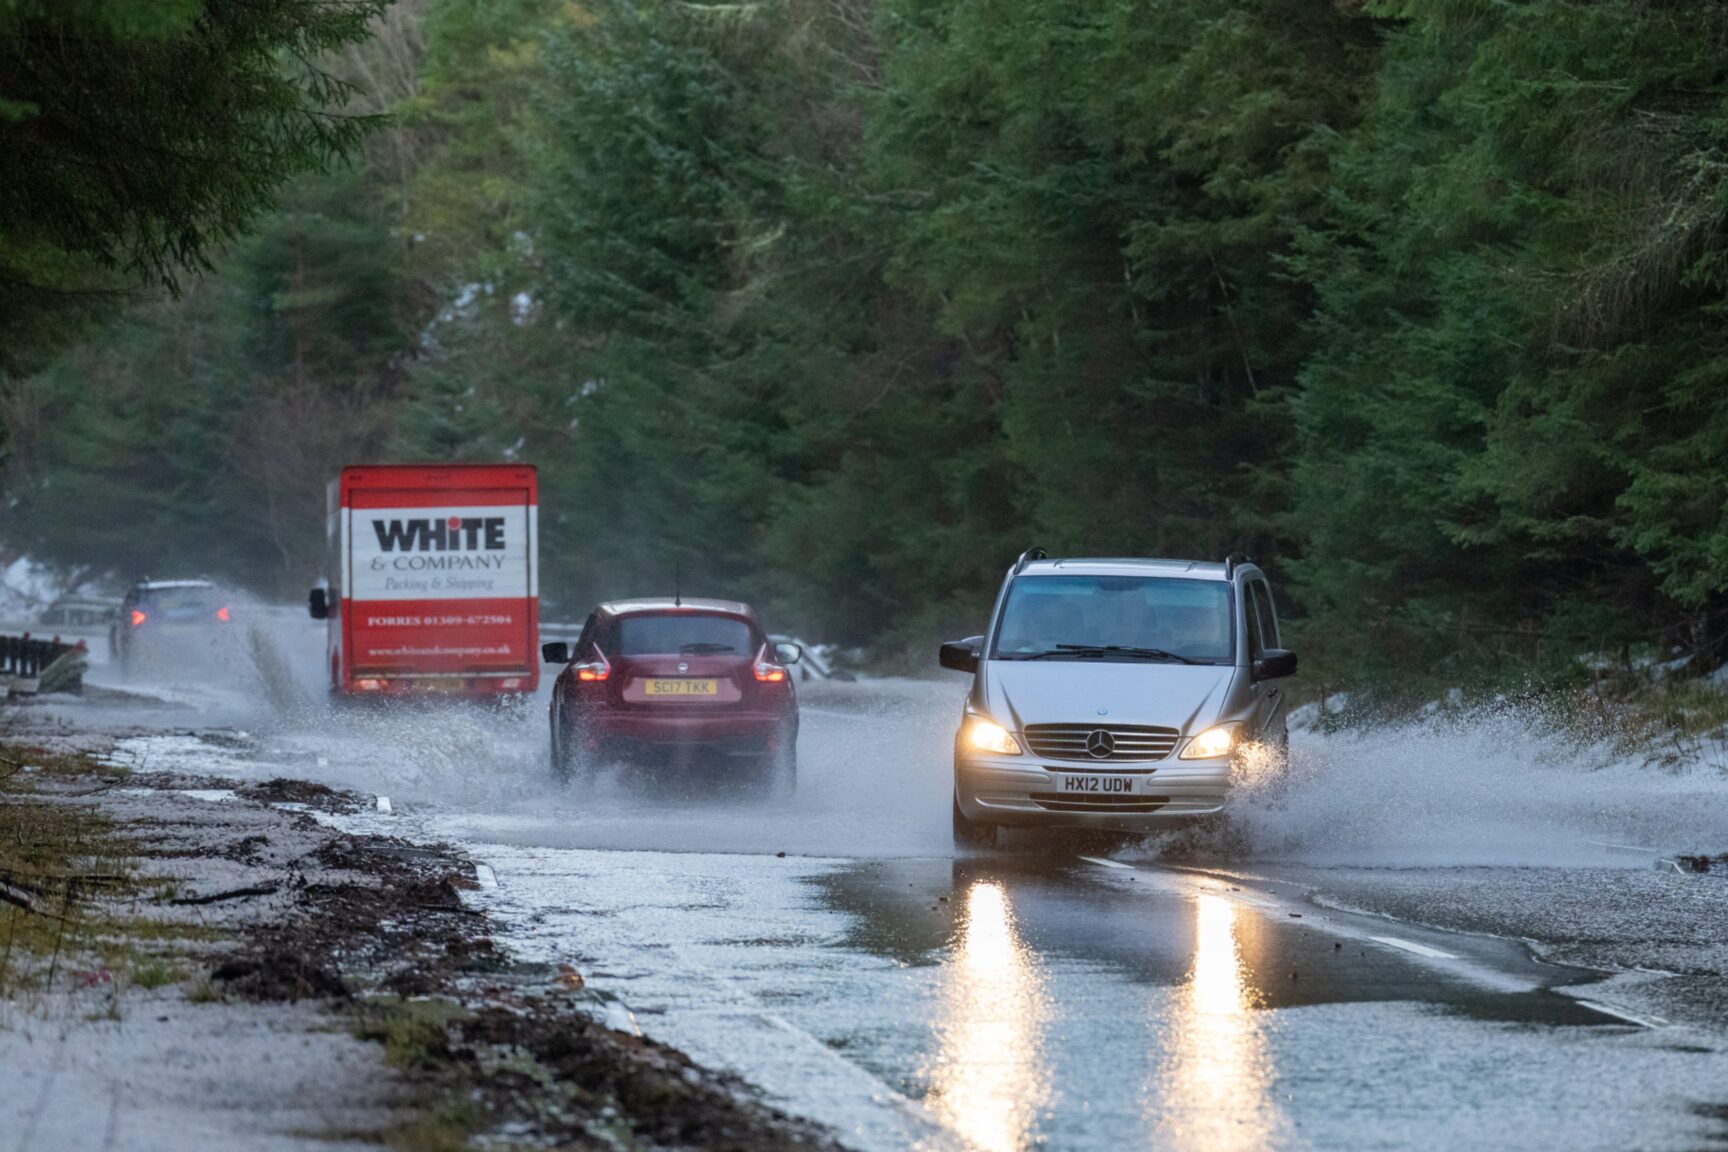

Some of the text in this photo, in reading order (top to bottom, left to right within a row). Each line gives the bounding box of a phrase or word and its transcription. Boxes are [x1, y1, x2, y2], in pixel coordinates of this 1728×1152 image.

[370, 555, 506, 571] & COMPANY
[385, 576, 494, 591] Packing & Shipping
[367, 616, 421, 627] FORRES
[654, 681, 709, 693] SC17 TKK
[1065, 777, 1133, 793] HX12 UDW
